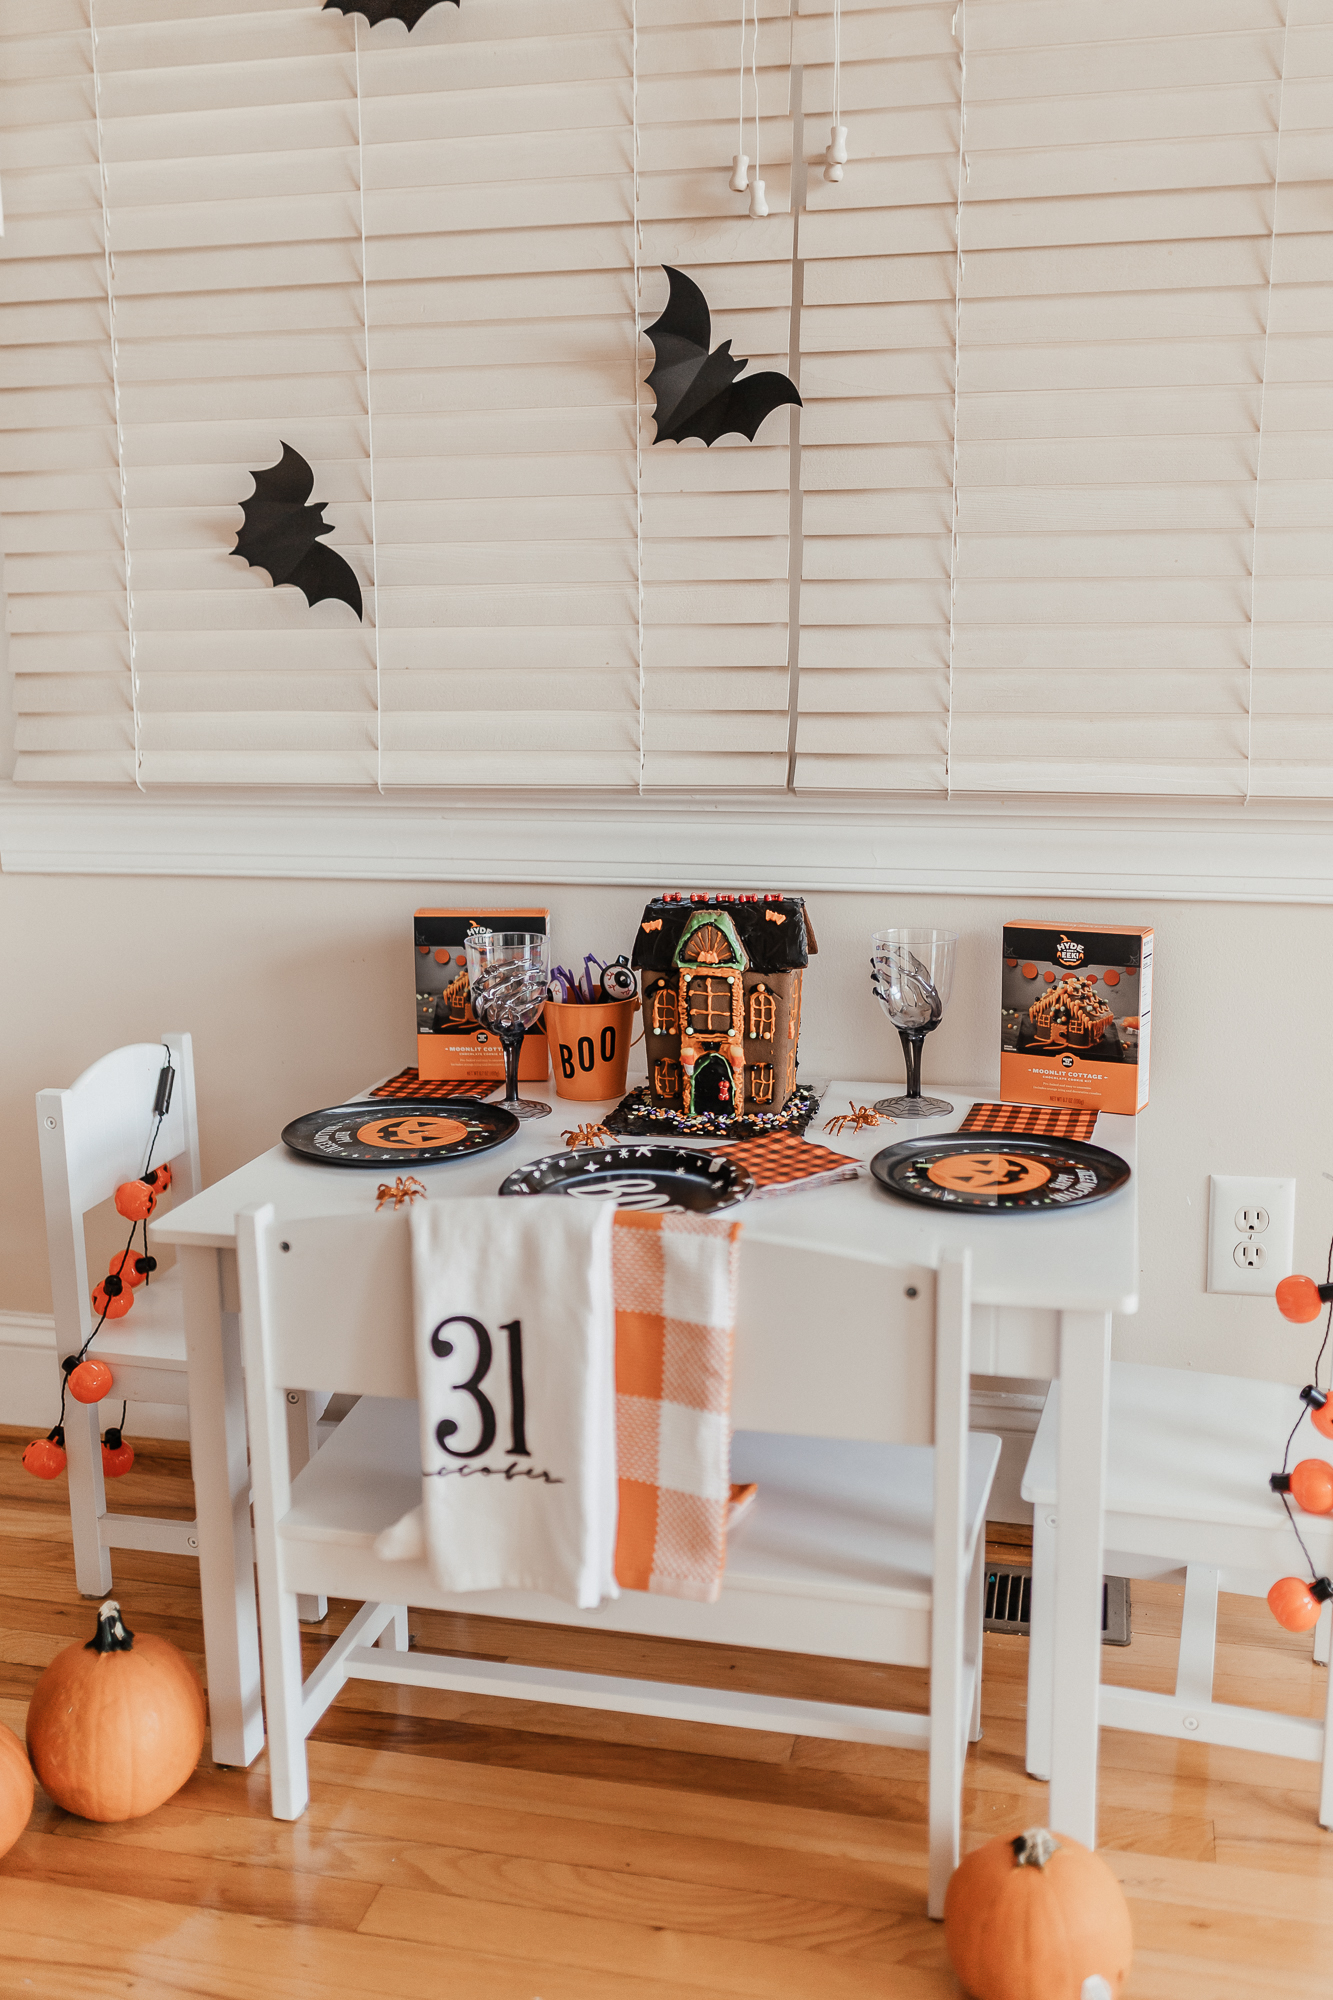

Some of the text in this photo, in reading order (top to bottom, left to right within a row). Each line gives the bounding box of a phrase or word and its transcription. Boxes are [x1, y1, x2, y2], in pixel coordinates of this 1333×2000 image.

[1056, 942, 1085, 954] HYDE
[559, 1026, 616, 1079] BOO
[1032, 1068, 1103, 1080] MOONLIT COTTAGE
[430, 1315, 532, 1459] 31
[422, 1462, 565, 1484] ctober
